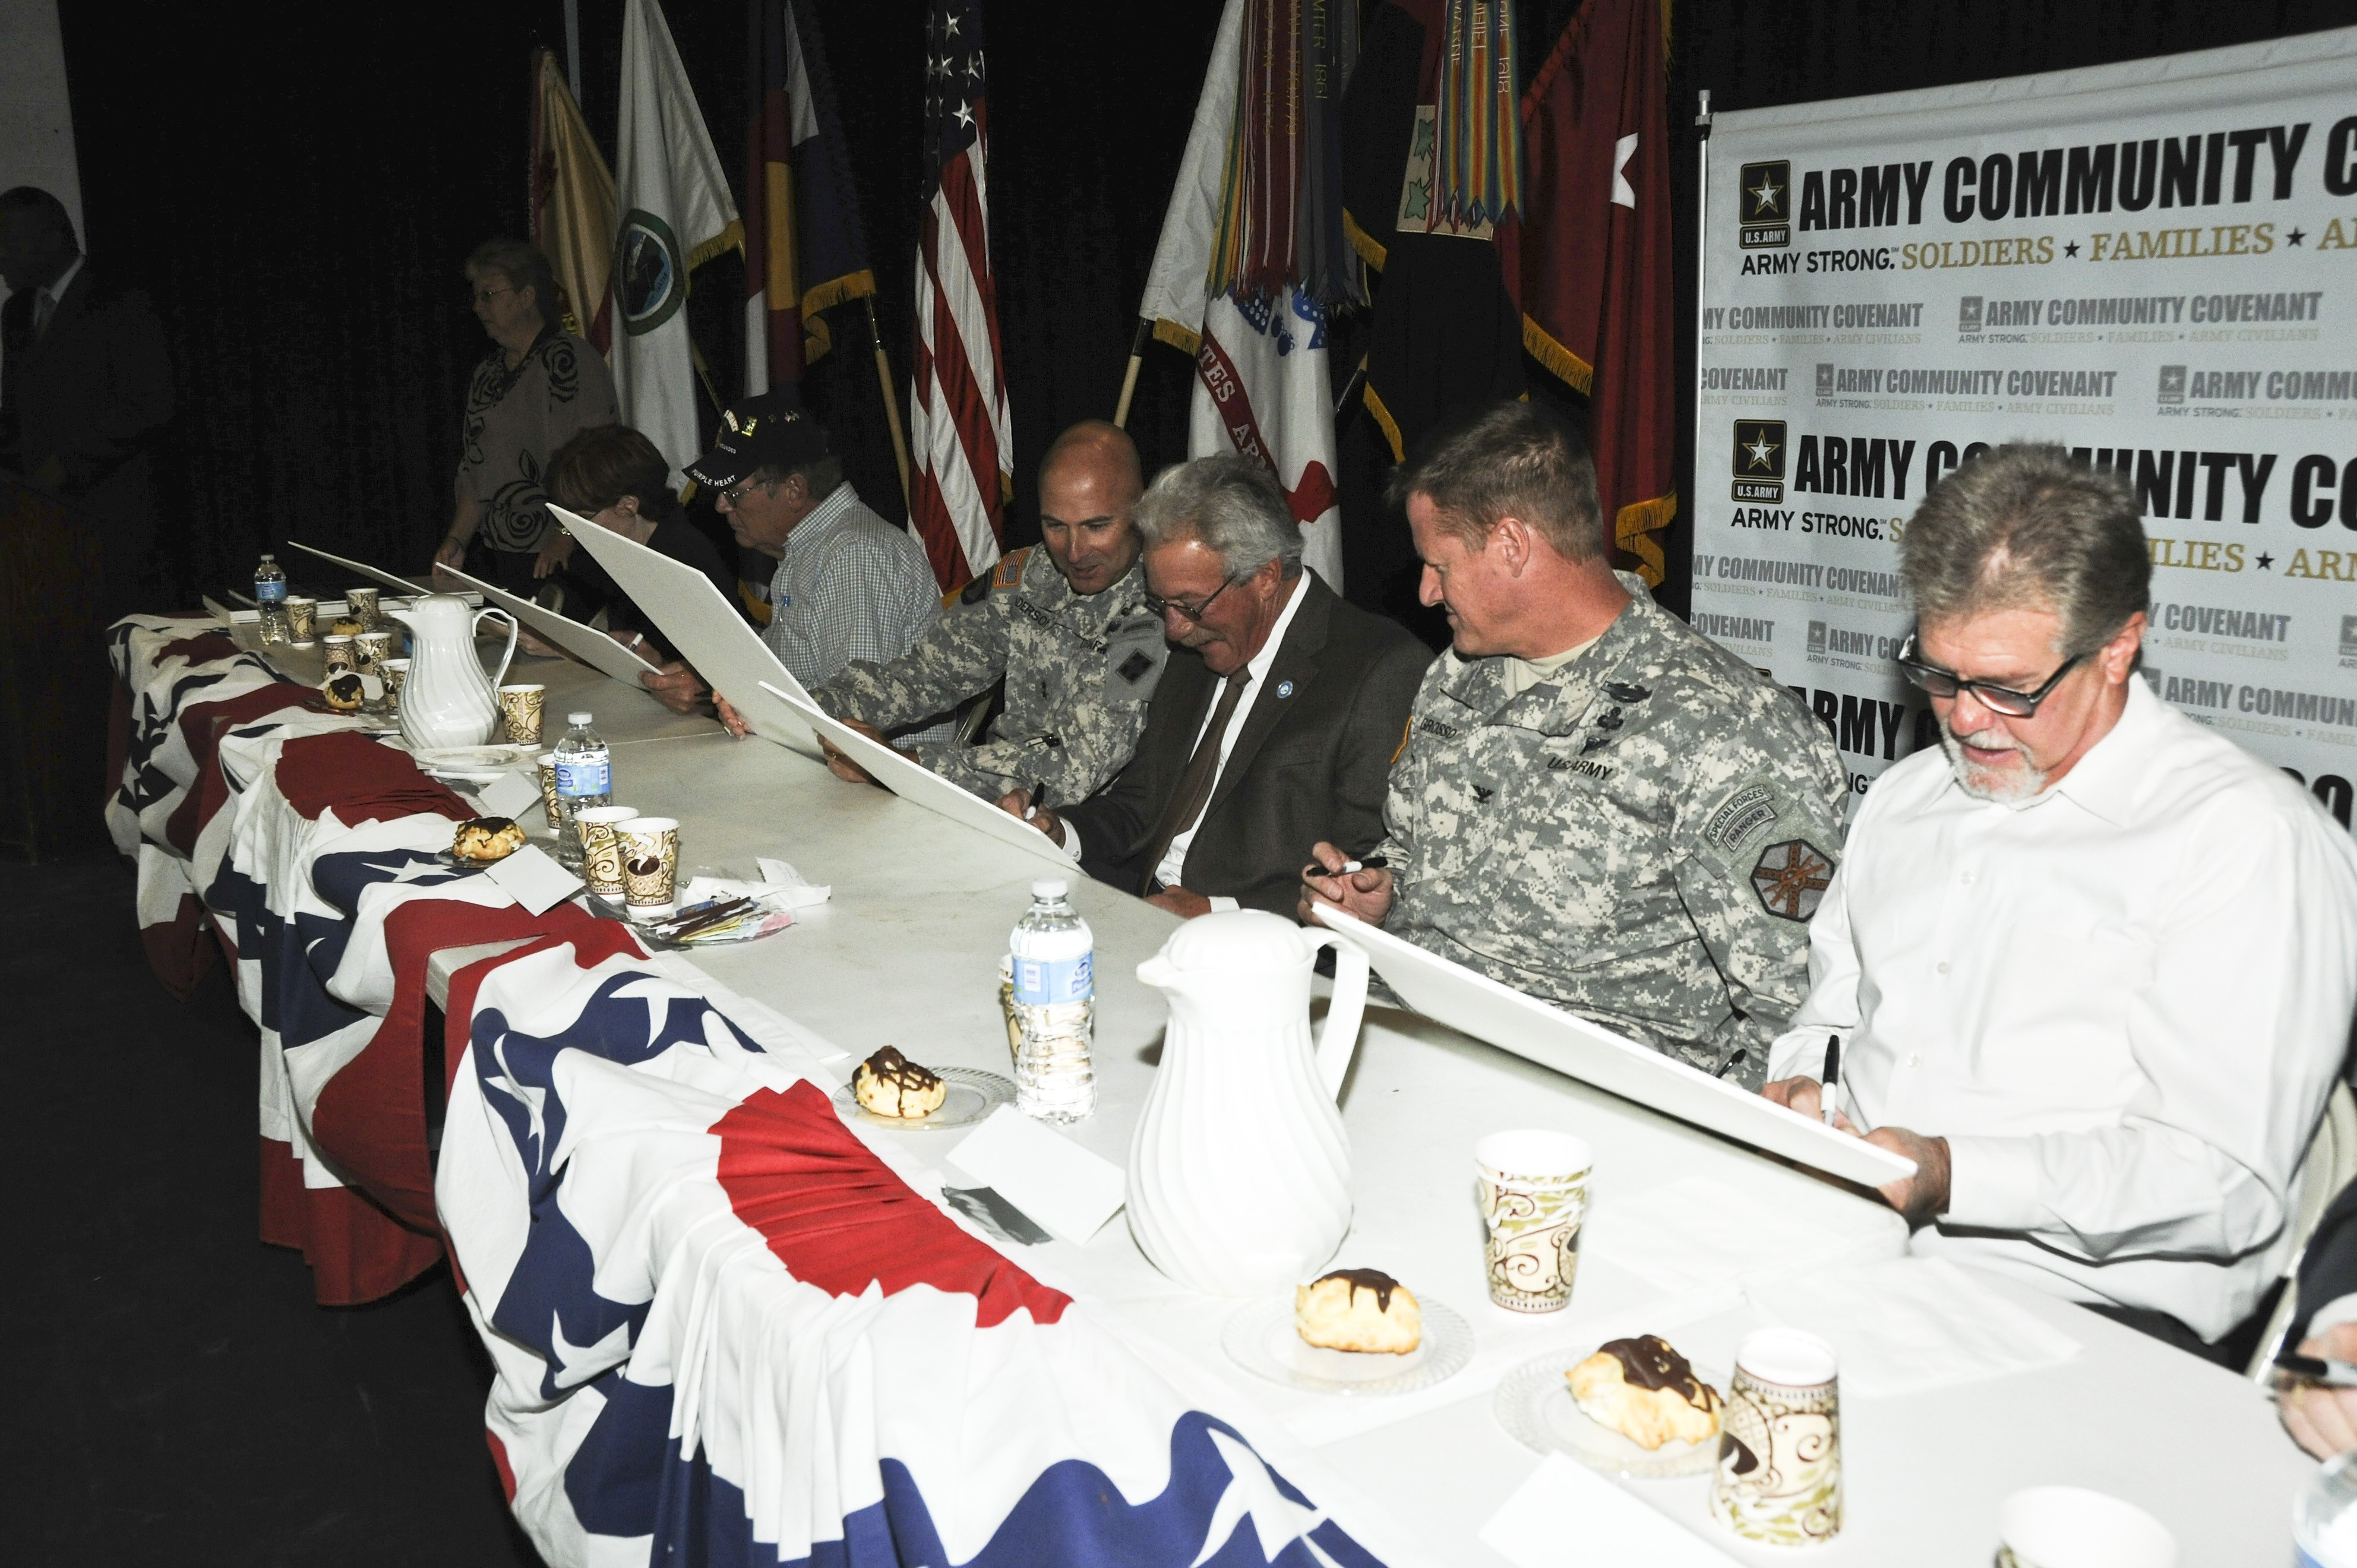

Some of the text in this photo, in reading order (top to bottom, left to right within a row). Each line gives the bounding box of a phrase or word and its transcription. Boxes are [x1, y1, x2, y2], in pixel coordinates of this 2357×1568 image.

[1799, 161, 1933, 231] ARMY
[1944, 123, 2311, 223] COMMUNITY
[1741, 252, 1801, 276] ARMY
[1807, 247, 1895, 273] STRONG.
[1902, 236, 2054, 270] SOLDIERS
[2089, 222, 2275, 262] FAMILIES
[1729, 305, 1830, 330] COMMUNITY
[1834, 303, 1924, 328] COVENANT
[1985, 292, 2323, 327] ARMY COMMUNITY COVENANT
[1714, 335, 1768, 344] SOLDIERS
[1779, 334, 1825, 344] FAMILIES
[1834, 334, 1863, 344] ARMY
[1865, 334, 1922, 344] CIVILIANS
[1958, 334, 1986, 343] ARMY
[1989, 334, 2028, 343] STRONG.
[2030, 331, 2093, 343] SOLDIERS
[2108, 331, 2175, 343] FAMILIES
[1837, 369, 2118, 397] ARMY COMMUNITY COVENANT
[2189, 371, 2262, 399] ARMY
[1701, 396, 1787, 406] RMY CIVILIANS
[1816, 399, 1837, 408] ARMY
[1873, 399, 1925, 410] SOLDIERS
[1936, 400, 1995, 412] FAMILIES
[2007, 402, 2043, 413] ARMY
[2046, 403, 2115, 416] CIVILIANS
[2157, 407, 2189, 416] ARMY
[691, 469, 736, 486] PURPLE HEART
[1793, 435, 1916, 500] ARMY
[1731, 508, 1794, 530] ARMY
[1802, 511, 1883, 540] STRONG.
[1718, 557, 1824, 587] COMMUNITY
[1704, 582, 1755, 596] SOLDIERS
[1767, 588, 1817, 602] FAMILIES
[1826, 595, 1854, 609] ARMY
[2165, 603, 2292, 642] COVENANT
[1829, 628, 1873, 656] ARMY
[1807, 654, 1829, 664] ARMY
[2165, 676, 2233, 709] ARMY
[1710, 789, 1764, 839] SPECIAL FORCES
[1729, 809, 1765, 843] RANGER
